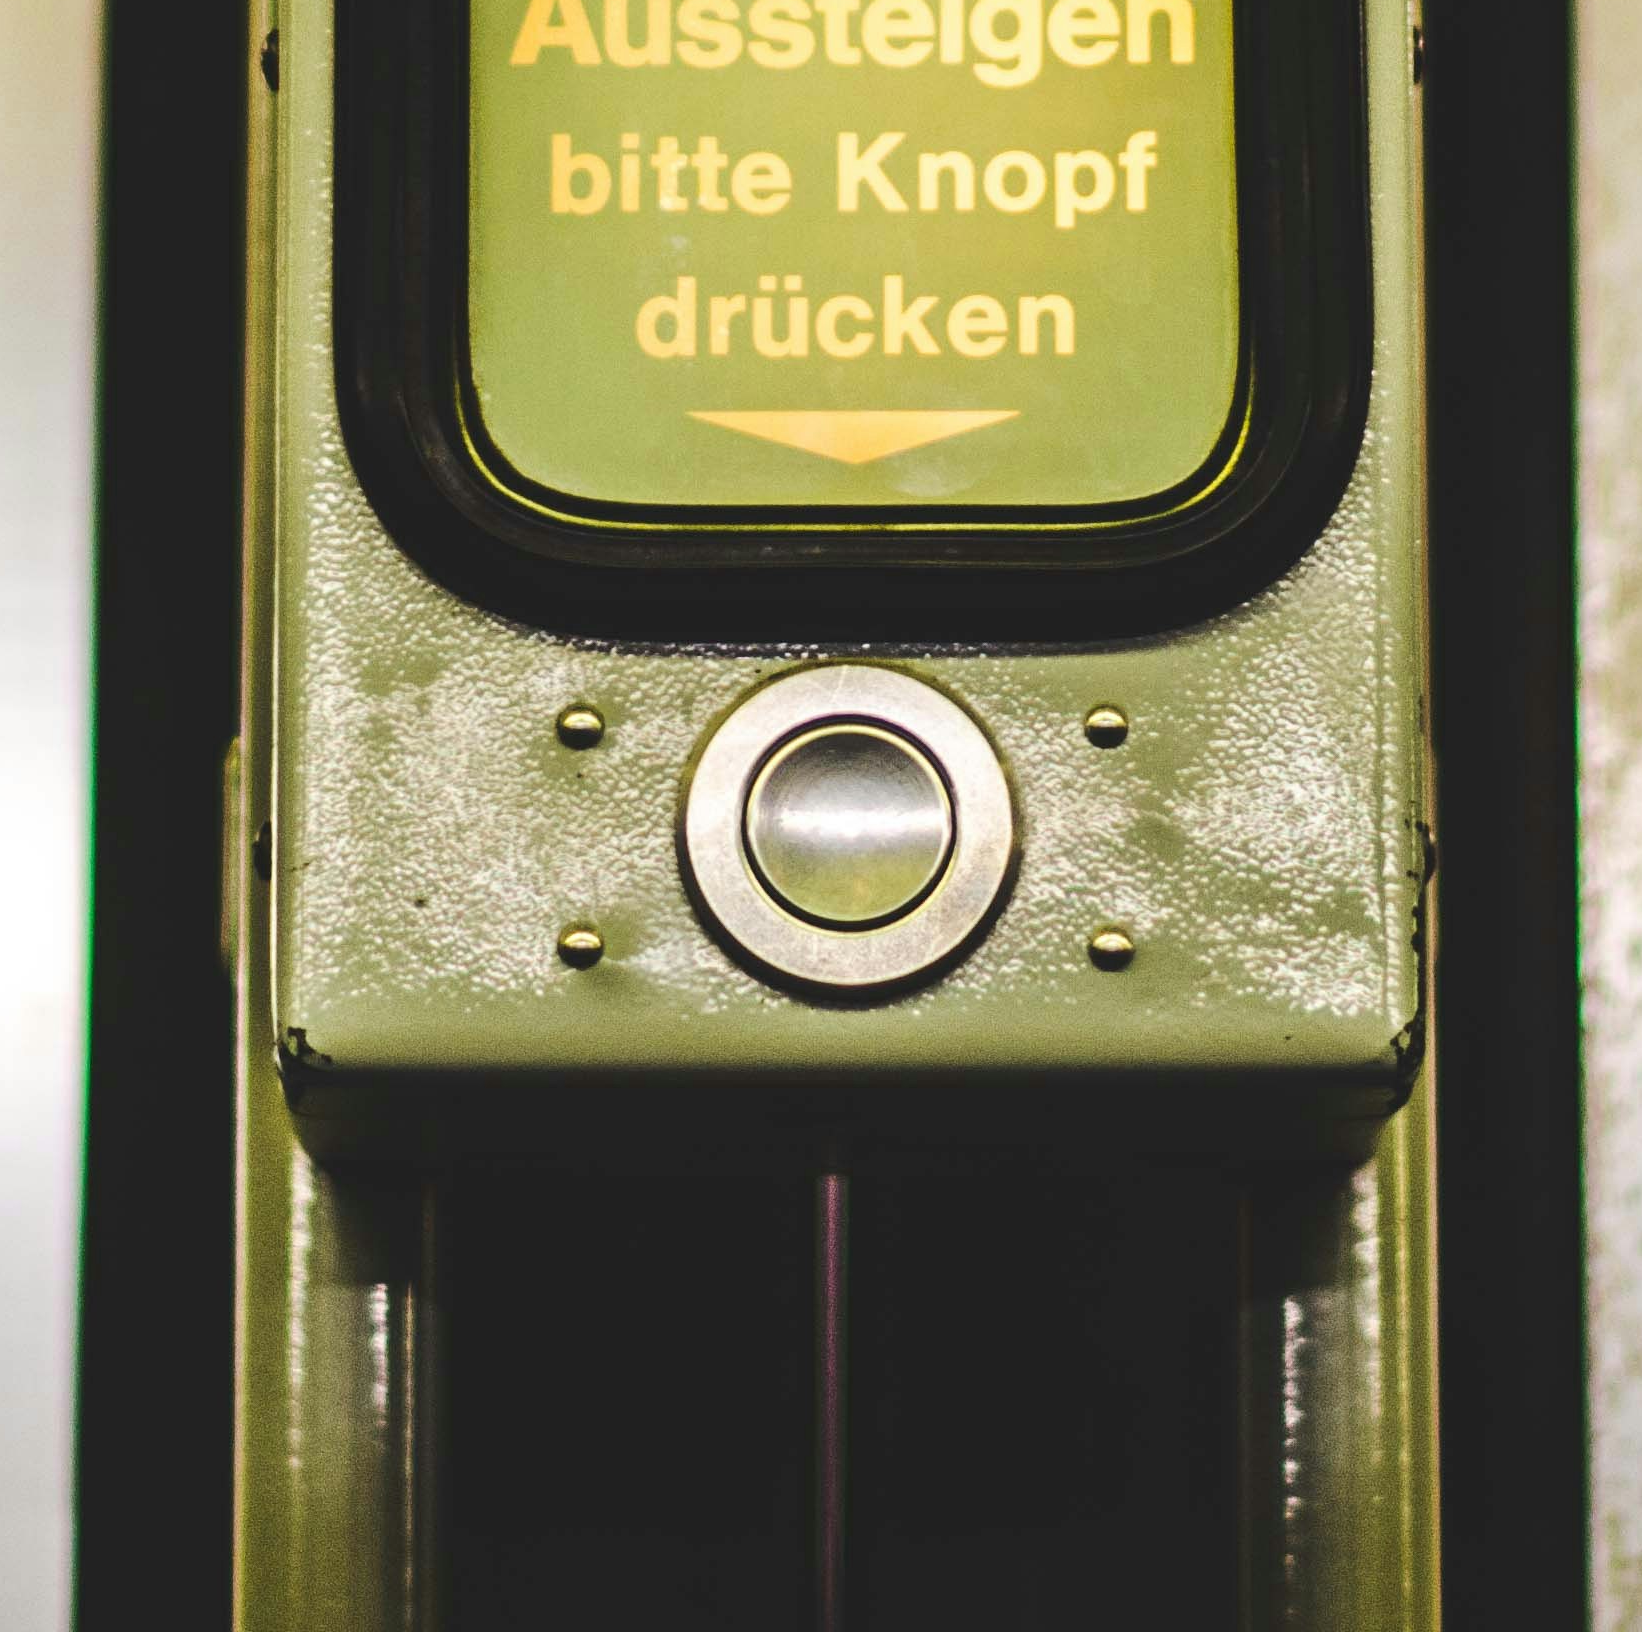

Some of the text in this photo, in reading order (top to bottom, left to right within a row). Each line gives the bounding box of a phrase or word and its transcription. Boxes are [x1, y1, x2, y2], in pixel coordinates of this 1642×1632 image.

[550, 130, 1159, 230] bitte Knopf
[635, 274, 1076, 360] drücken
